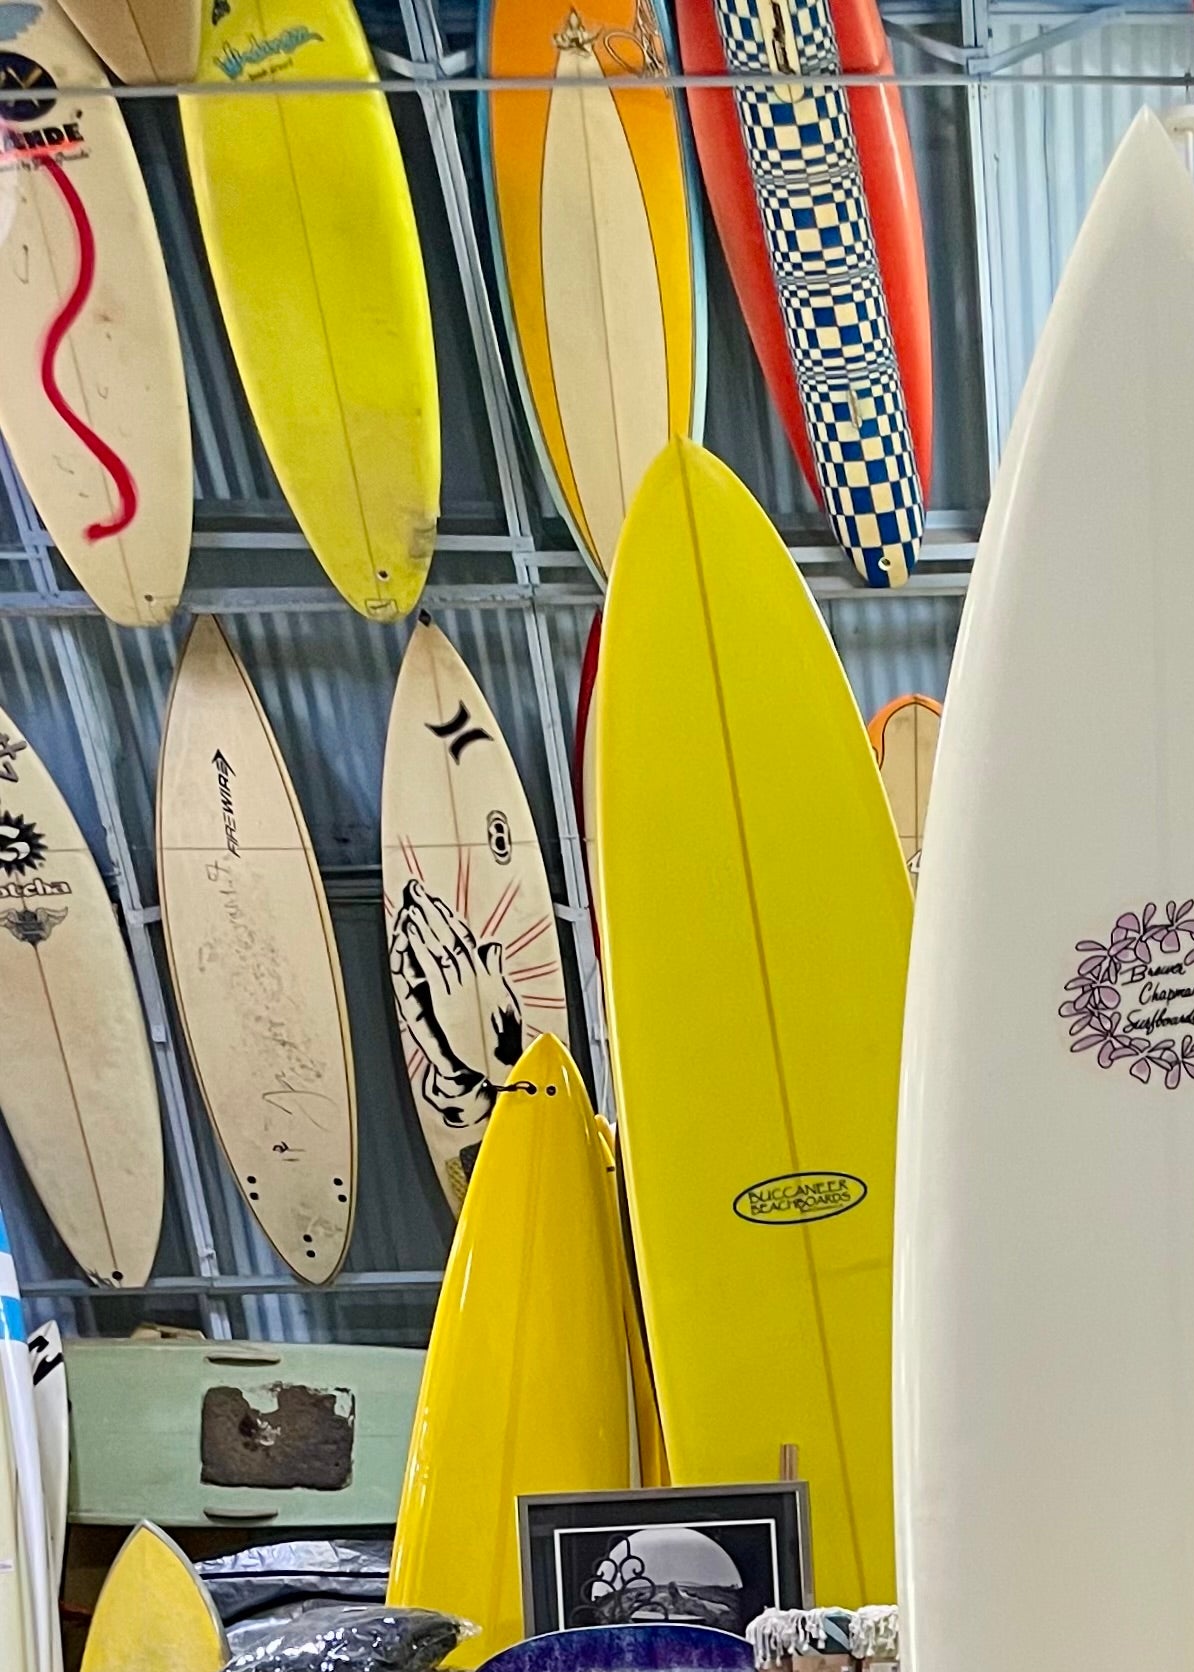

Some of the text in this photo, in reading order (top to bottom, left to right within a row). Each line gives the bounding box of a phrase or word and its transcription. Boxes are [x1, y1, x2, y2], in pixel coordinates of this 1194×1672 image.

[213, 757, 241, 859] FIREWIRE
[748, 1179, 849, 1205] BUCCANEER
[750, 1191, 851, 1216] BEACHBOARDS
